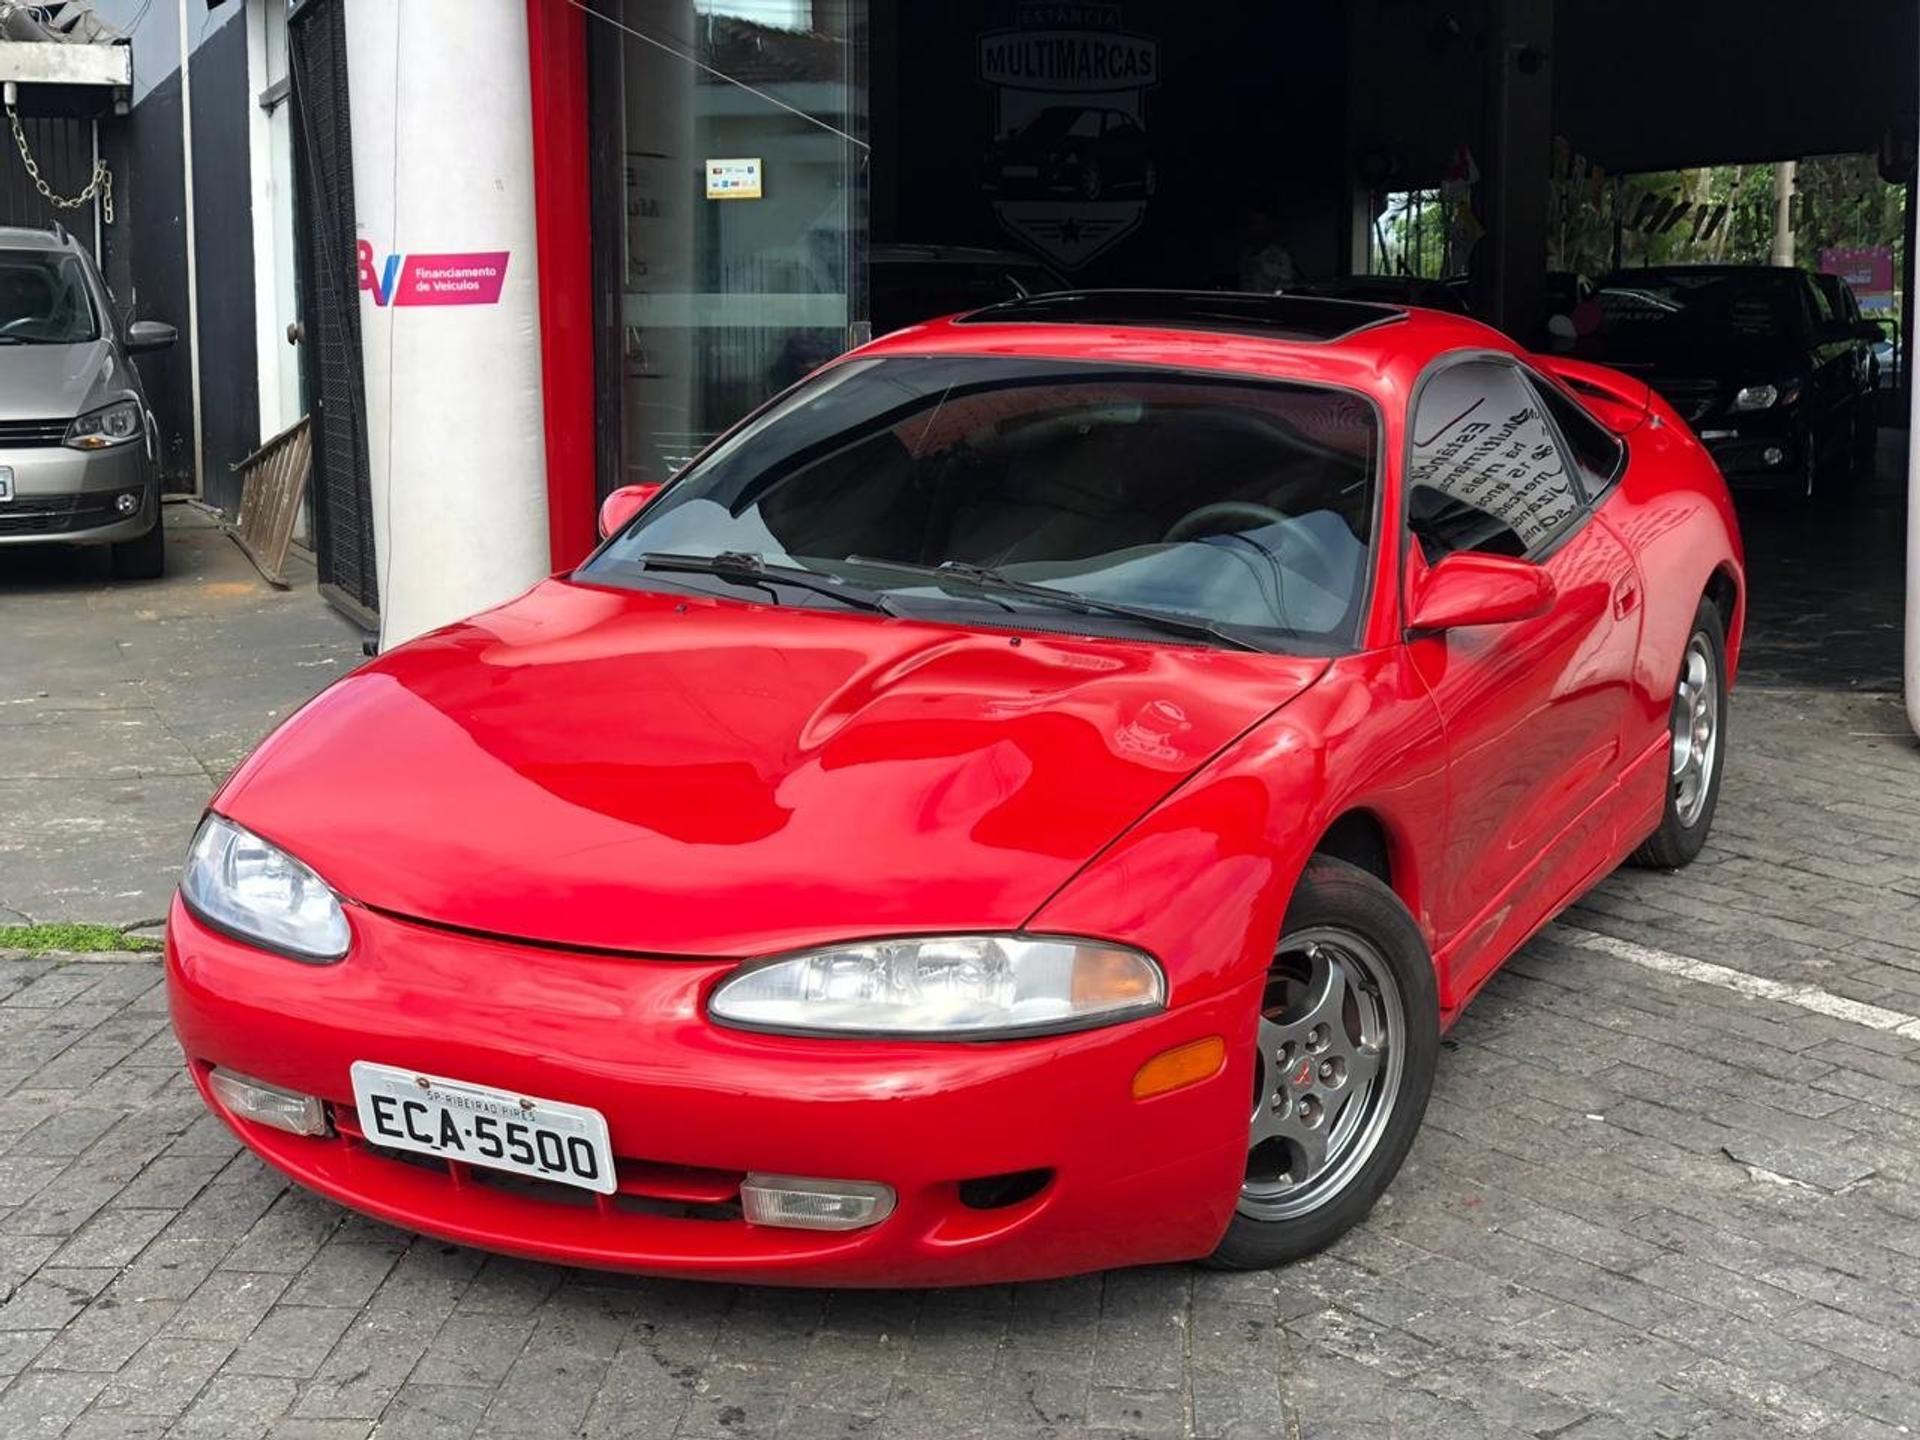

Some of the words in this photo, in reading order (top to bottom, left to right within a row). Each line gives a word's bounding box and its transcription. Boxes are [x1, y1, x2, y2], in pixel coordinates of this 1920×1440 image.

[985, 38, 1152, 80] MULTIMARCAS
[356, 239, 401, 307] BV
[415, 266, 498, 280] Financiamento
[415, 279, 431, 292] de
[502, 1104, 537, 1122] PIRES
